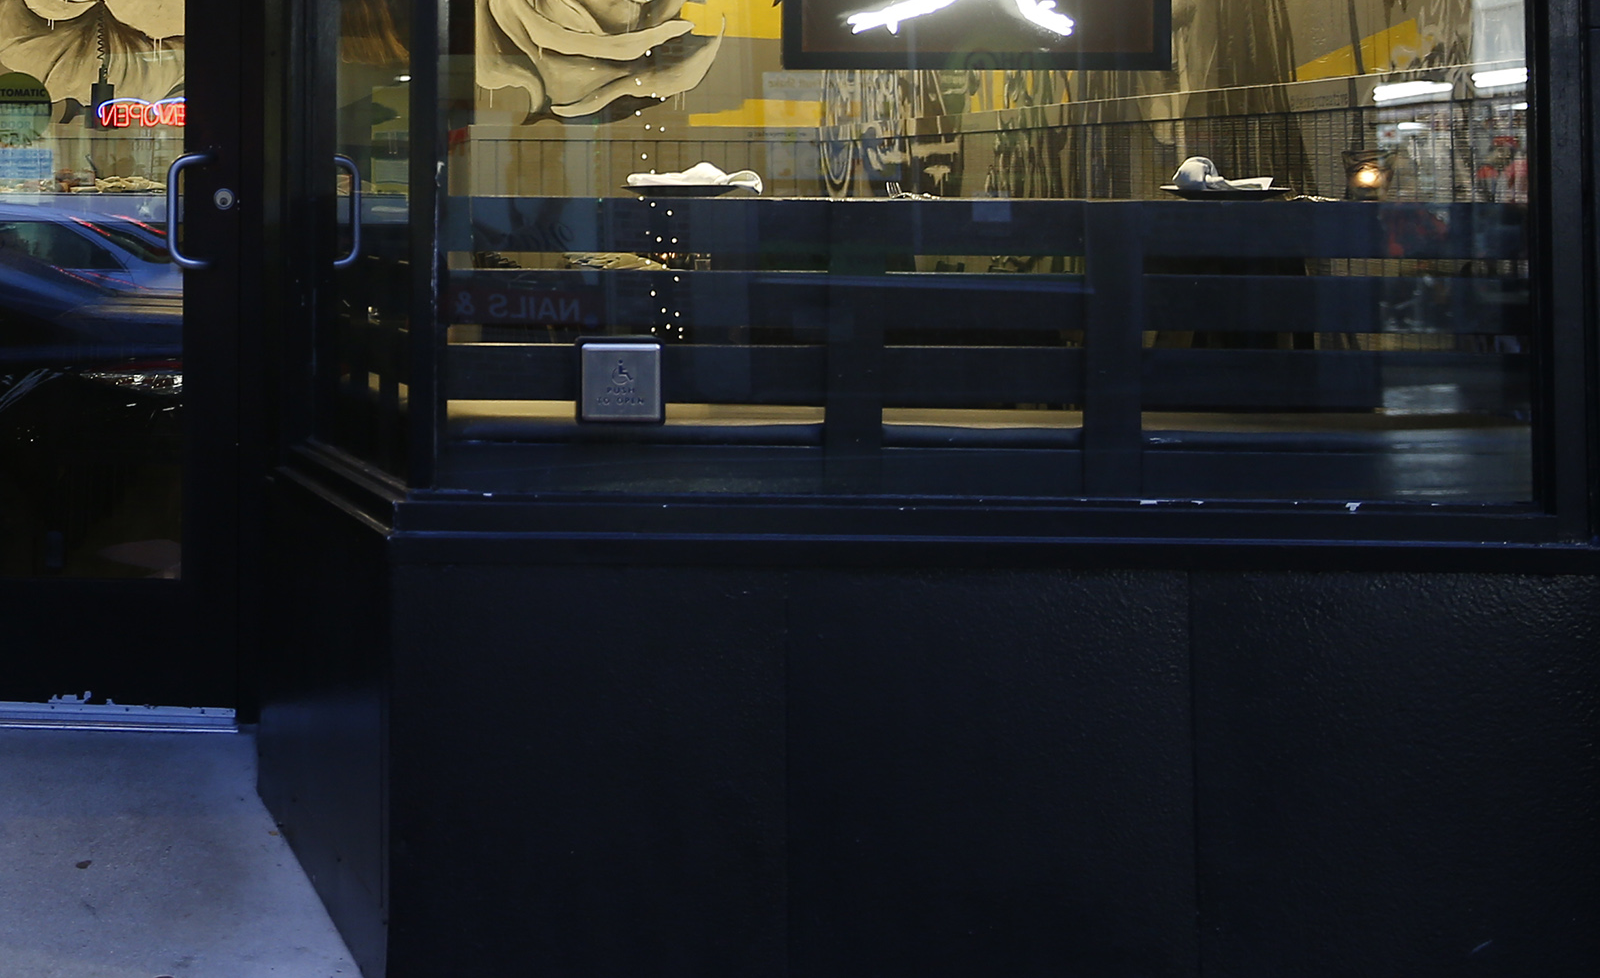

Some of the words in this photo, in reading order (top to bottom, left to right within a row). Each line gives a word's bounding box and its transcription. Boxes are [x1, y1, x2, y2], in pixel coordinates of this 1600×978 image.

[1, 120, 32, 129] DOOR
[606, 386, 636, 396] PUSH
[596, 396, 611, 406] TO
[616, 396, 645, 406] OPEN
